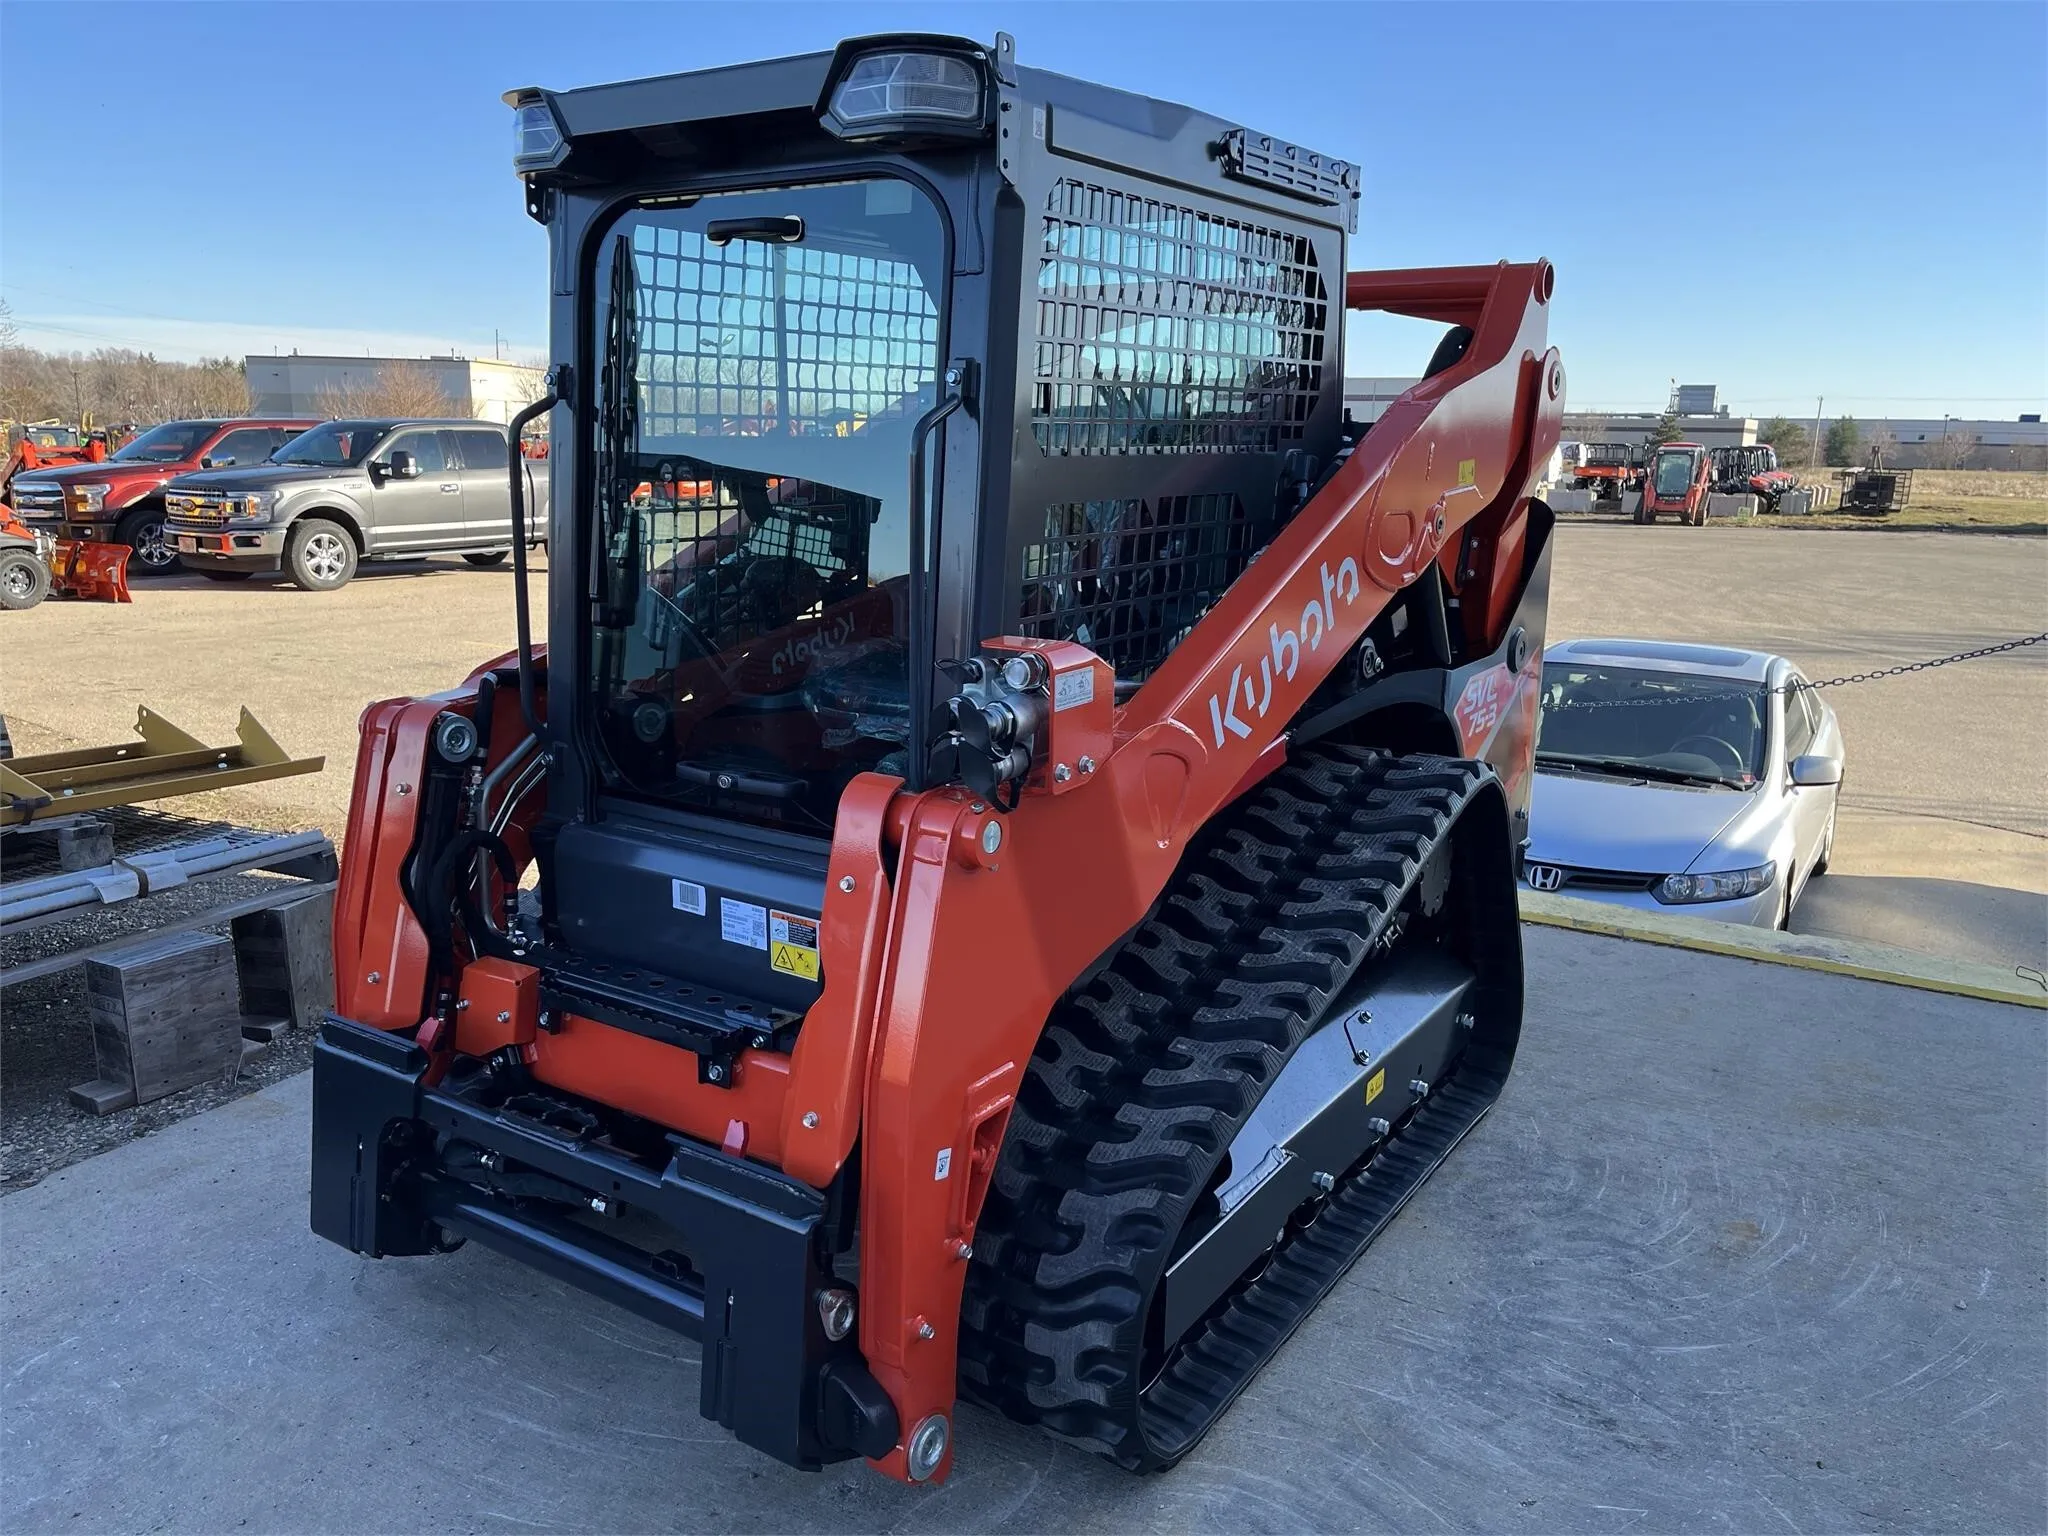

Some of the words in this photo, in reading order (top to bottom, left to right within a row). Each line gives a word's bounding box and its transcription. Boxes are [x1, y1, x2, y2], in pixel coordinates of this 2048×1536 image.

[1208, 556, 1360, 750] Kubota
[1463, 675, 1498, 715] SVL
[1467, 703, 1498, 737] 75-3
